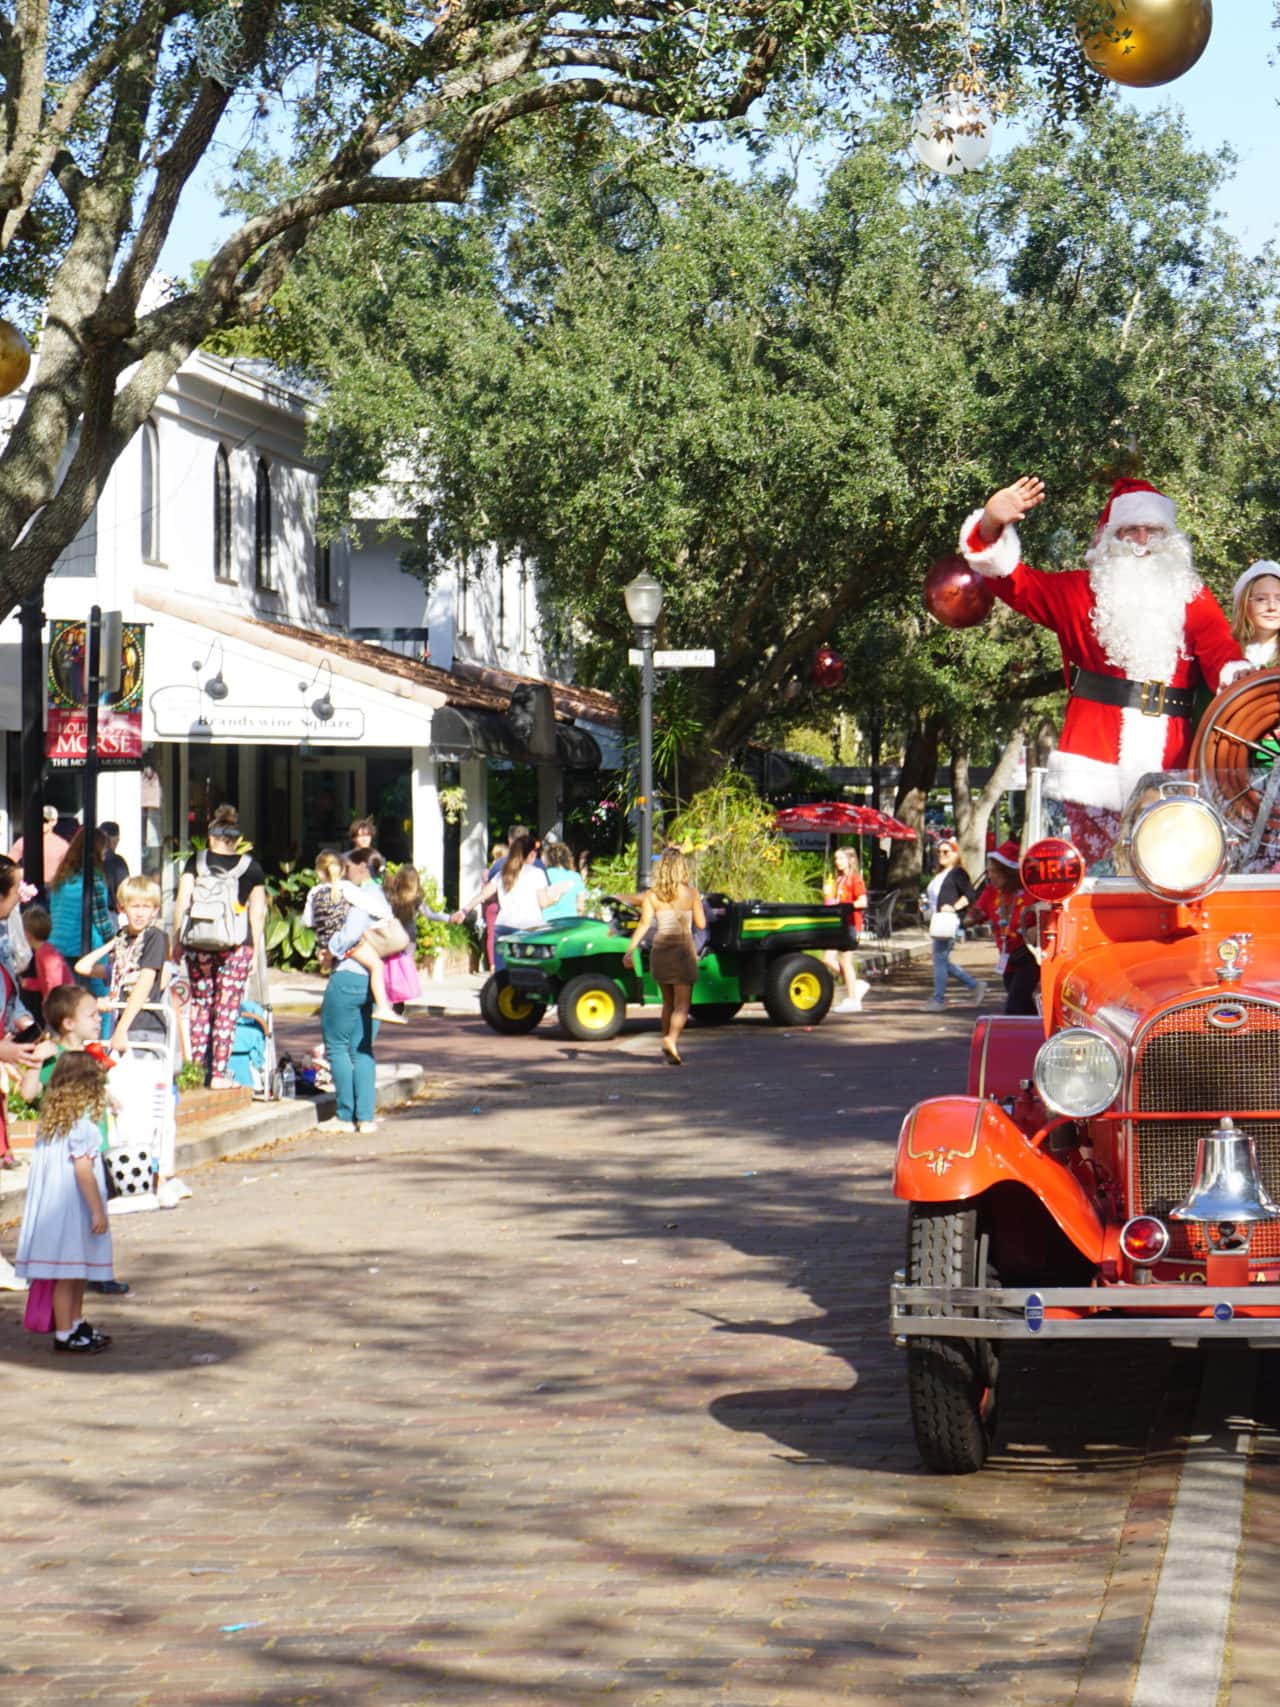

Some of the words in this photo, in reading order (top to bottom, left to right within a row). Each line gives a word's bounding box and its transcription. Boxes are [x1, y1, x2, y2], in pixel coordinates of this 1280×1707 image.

[199, 714, 292, 728] Brandywine
[301, 717, 353, 730] Square
[1024, 858, 1078, 880] FIRE
